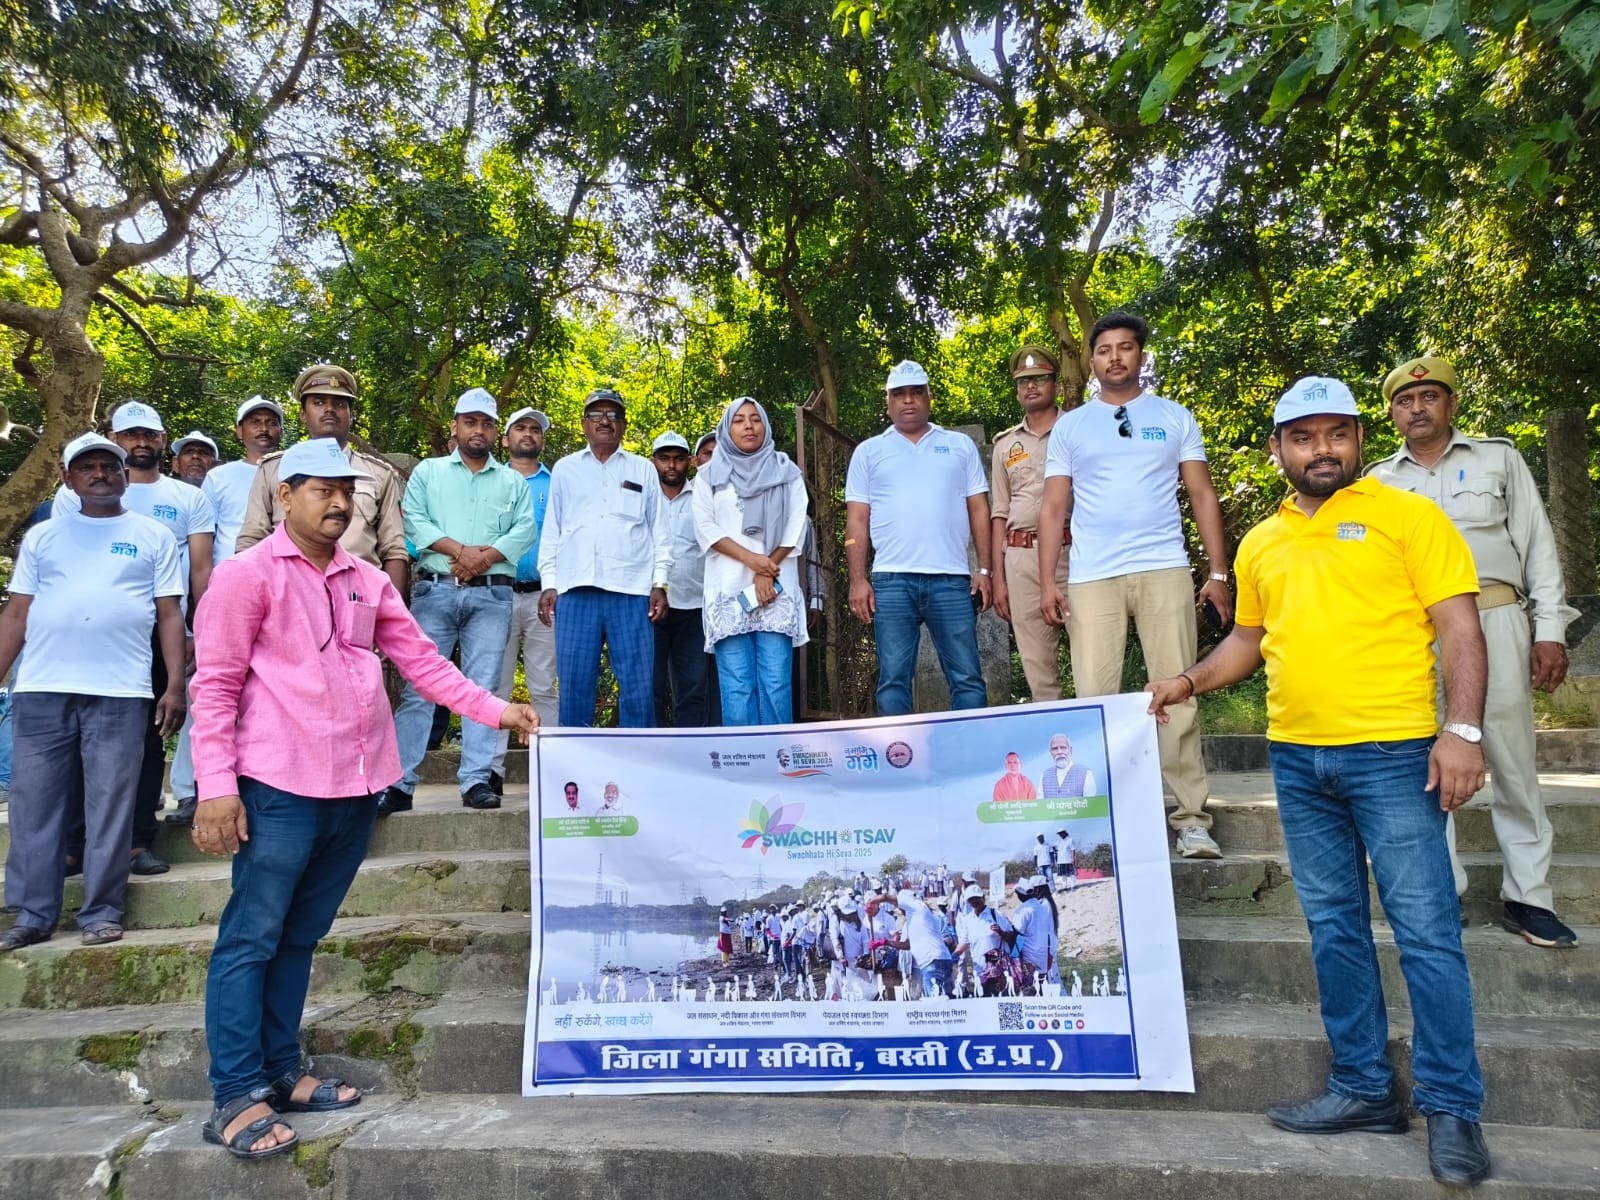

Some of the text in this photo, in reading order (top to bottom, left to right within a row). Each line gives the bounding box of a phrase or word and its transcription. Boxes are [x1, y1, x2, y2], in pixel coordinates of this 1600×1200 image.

[792, 751, 829, 759] SWACHHATA
[787, 847, 872, 860] Swachhata Hi Seva 2025
[554, 1014, 573, 1028] नहीं
[630, 1012, 653, 1025] करेंगे
[720, 1011, 730, 1019] नदी
[601, 1039, 1064, 1071] जिला गंगा समिति, बस्ती (उ.प्र.)
